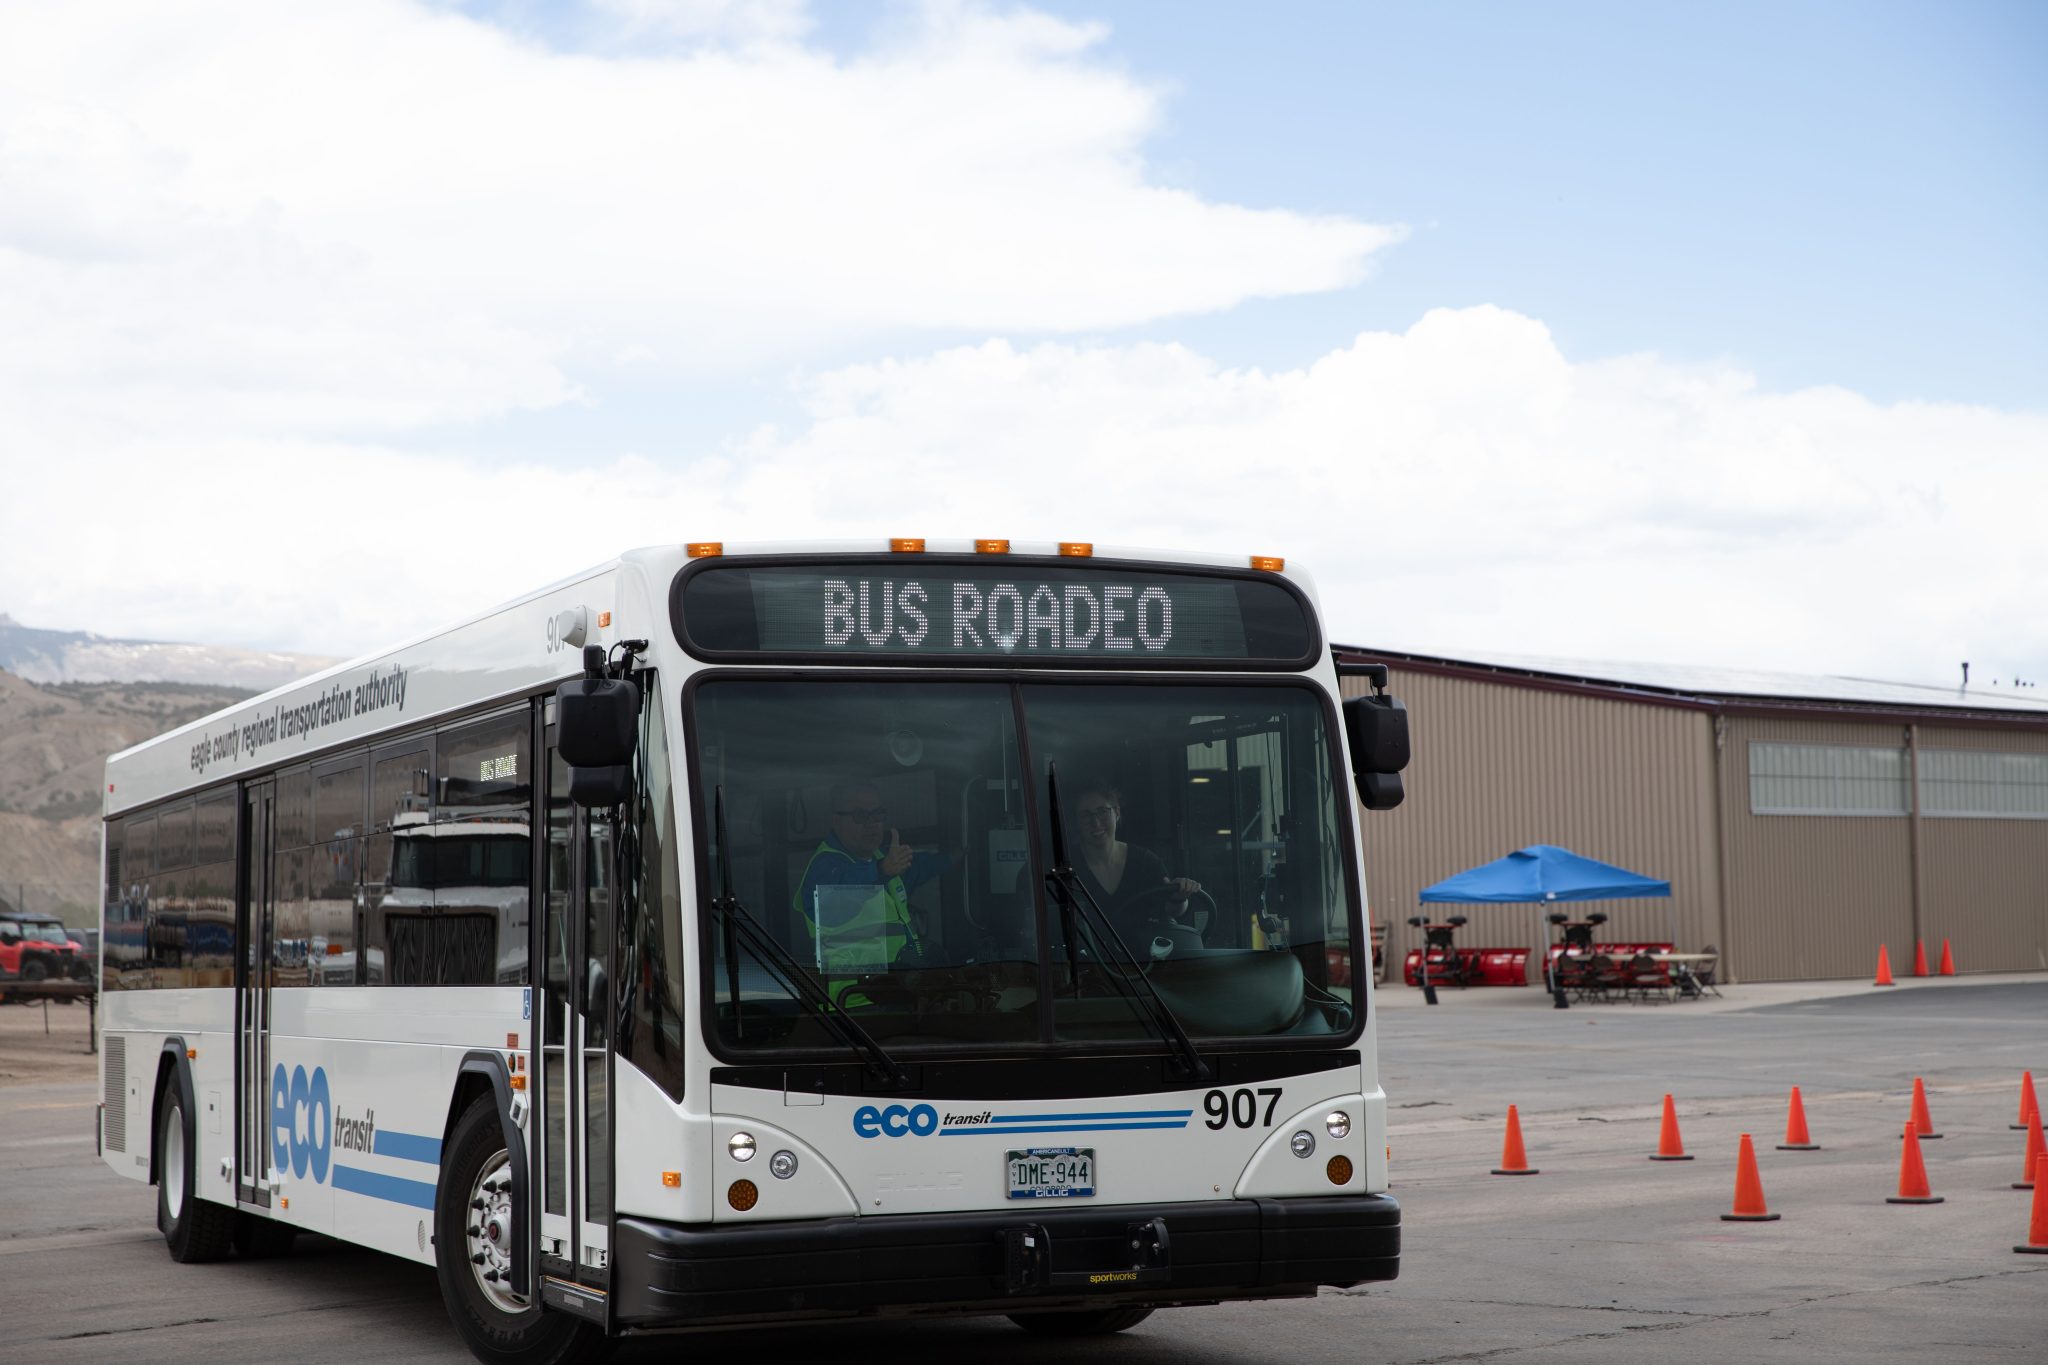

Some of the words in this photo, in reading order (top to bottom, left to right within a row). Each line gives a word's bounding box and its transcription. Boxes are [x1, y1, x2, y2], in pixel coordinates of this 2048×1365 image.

[547, 614, 565, 654] 90
[824, 580, 929, 647] BUS
[953, 583, 1173, 650] ROADEO
[190, 733, 212, 774] eagle
[213, 723, 241, 762] county
[241, 706, 279, 757] regional
[280, 683, 352, 741] transportation
[354, 663, 408, 712] authority
[272, 1063, 331, 1184] eco
[334, 1105, 374, 1154] transit
[853, 1104, 939, 1138] eco
[943, 1111, 992, 1126] transit
[1204, 1088, 1282, 1130] 907
[1036, 1189, 1068, 1197] GILLIG
[1090, 1272, 1137, 1284] sportworks
